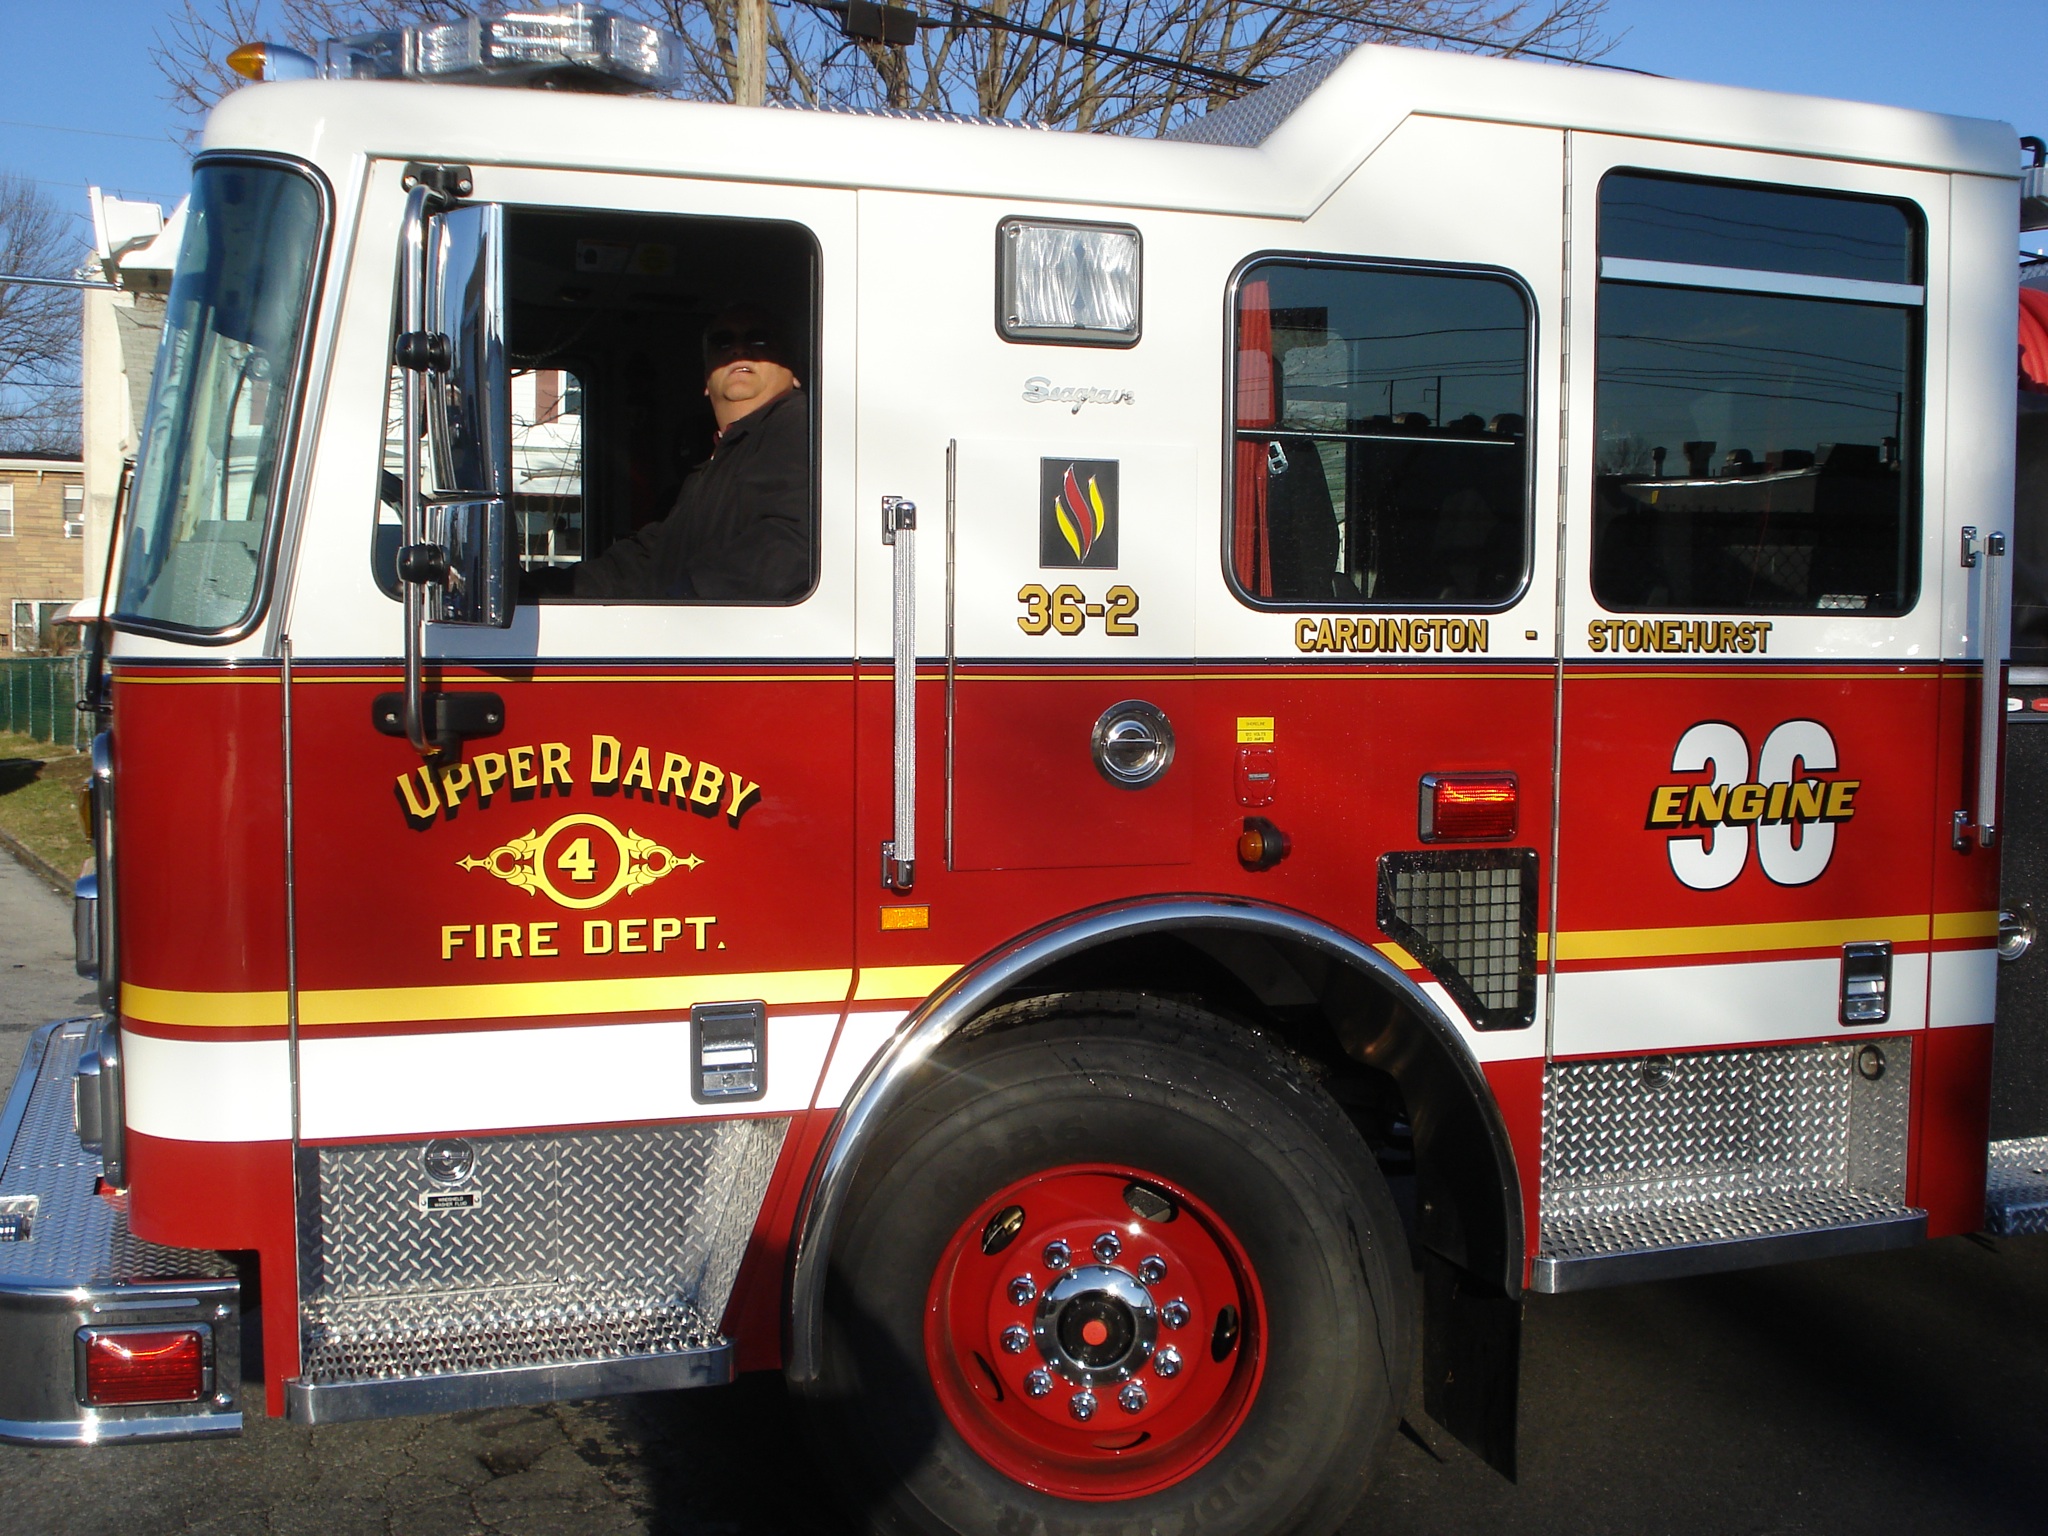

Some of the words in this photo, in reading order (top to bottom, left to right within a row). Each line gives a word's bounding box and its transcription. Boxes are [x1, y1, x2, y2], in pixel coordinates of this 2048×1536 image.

[1021, 376, 1136, 415] Seagrave
[1017, 584, 1139, 636] 36-2
[1294, 617, 1489, 652] CARDINGTON
[1587, 619, 1773, 653] STONEHURST
[395, 742, 574, 828] UPPER
[589, 734, 760, 826] DARBY
[1645, 780, 1860, 830] ENGINE
[1667, 718, 1839, 892] 36
[557, 837, 597, 882] 4
[441, 921, 560, 960] FIRE
[583, 916, 727, 956] DEPT.
